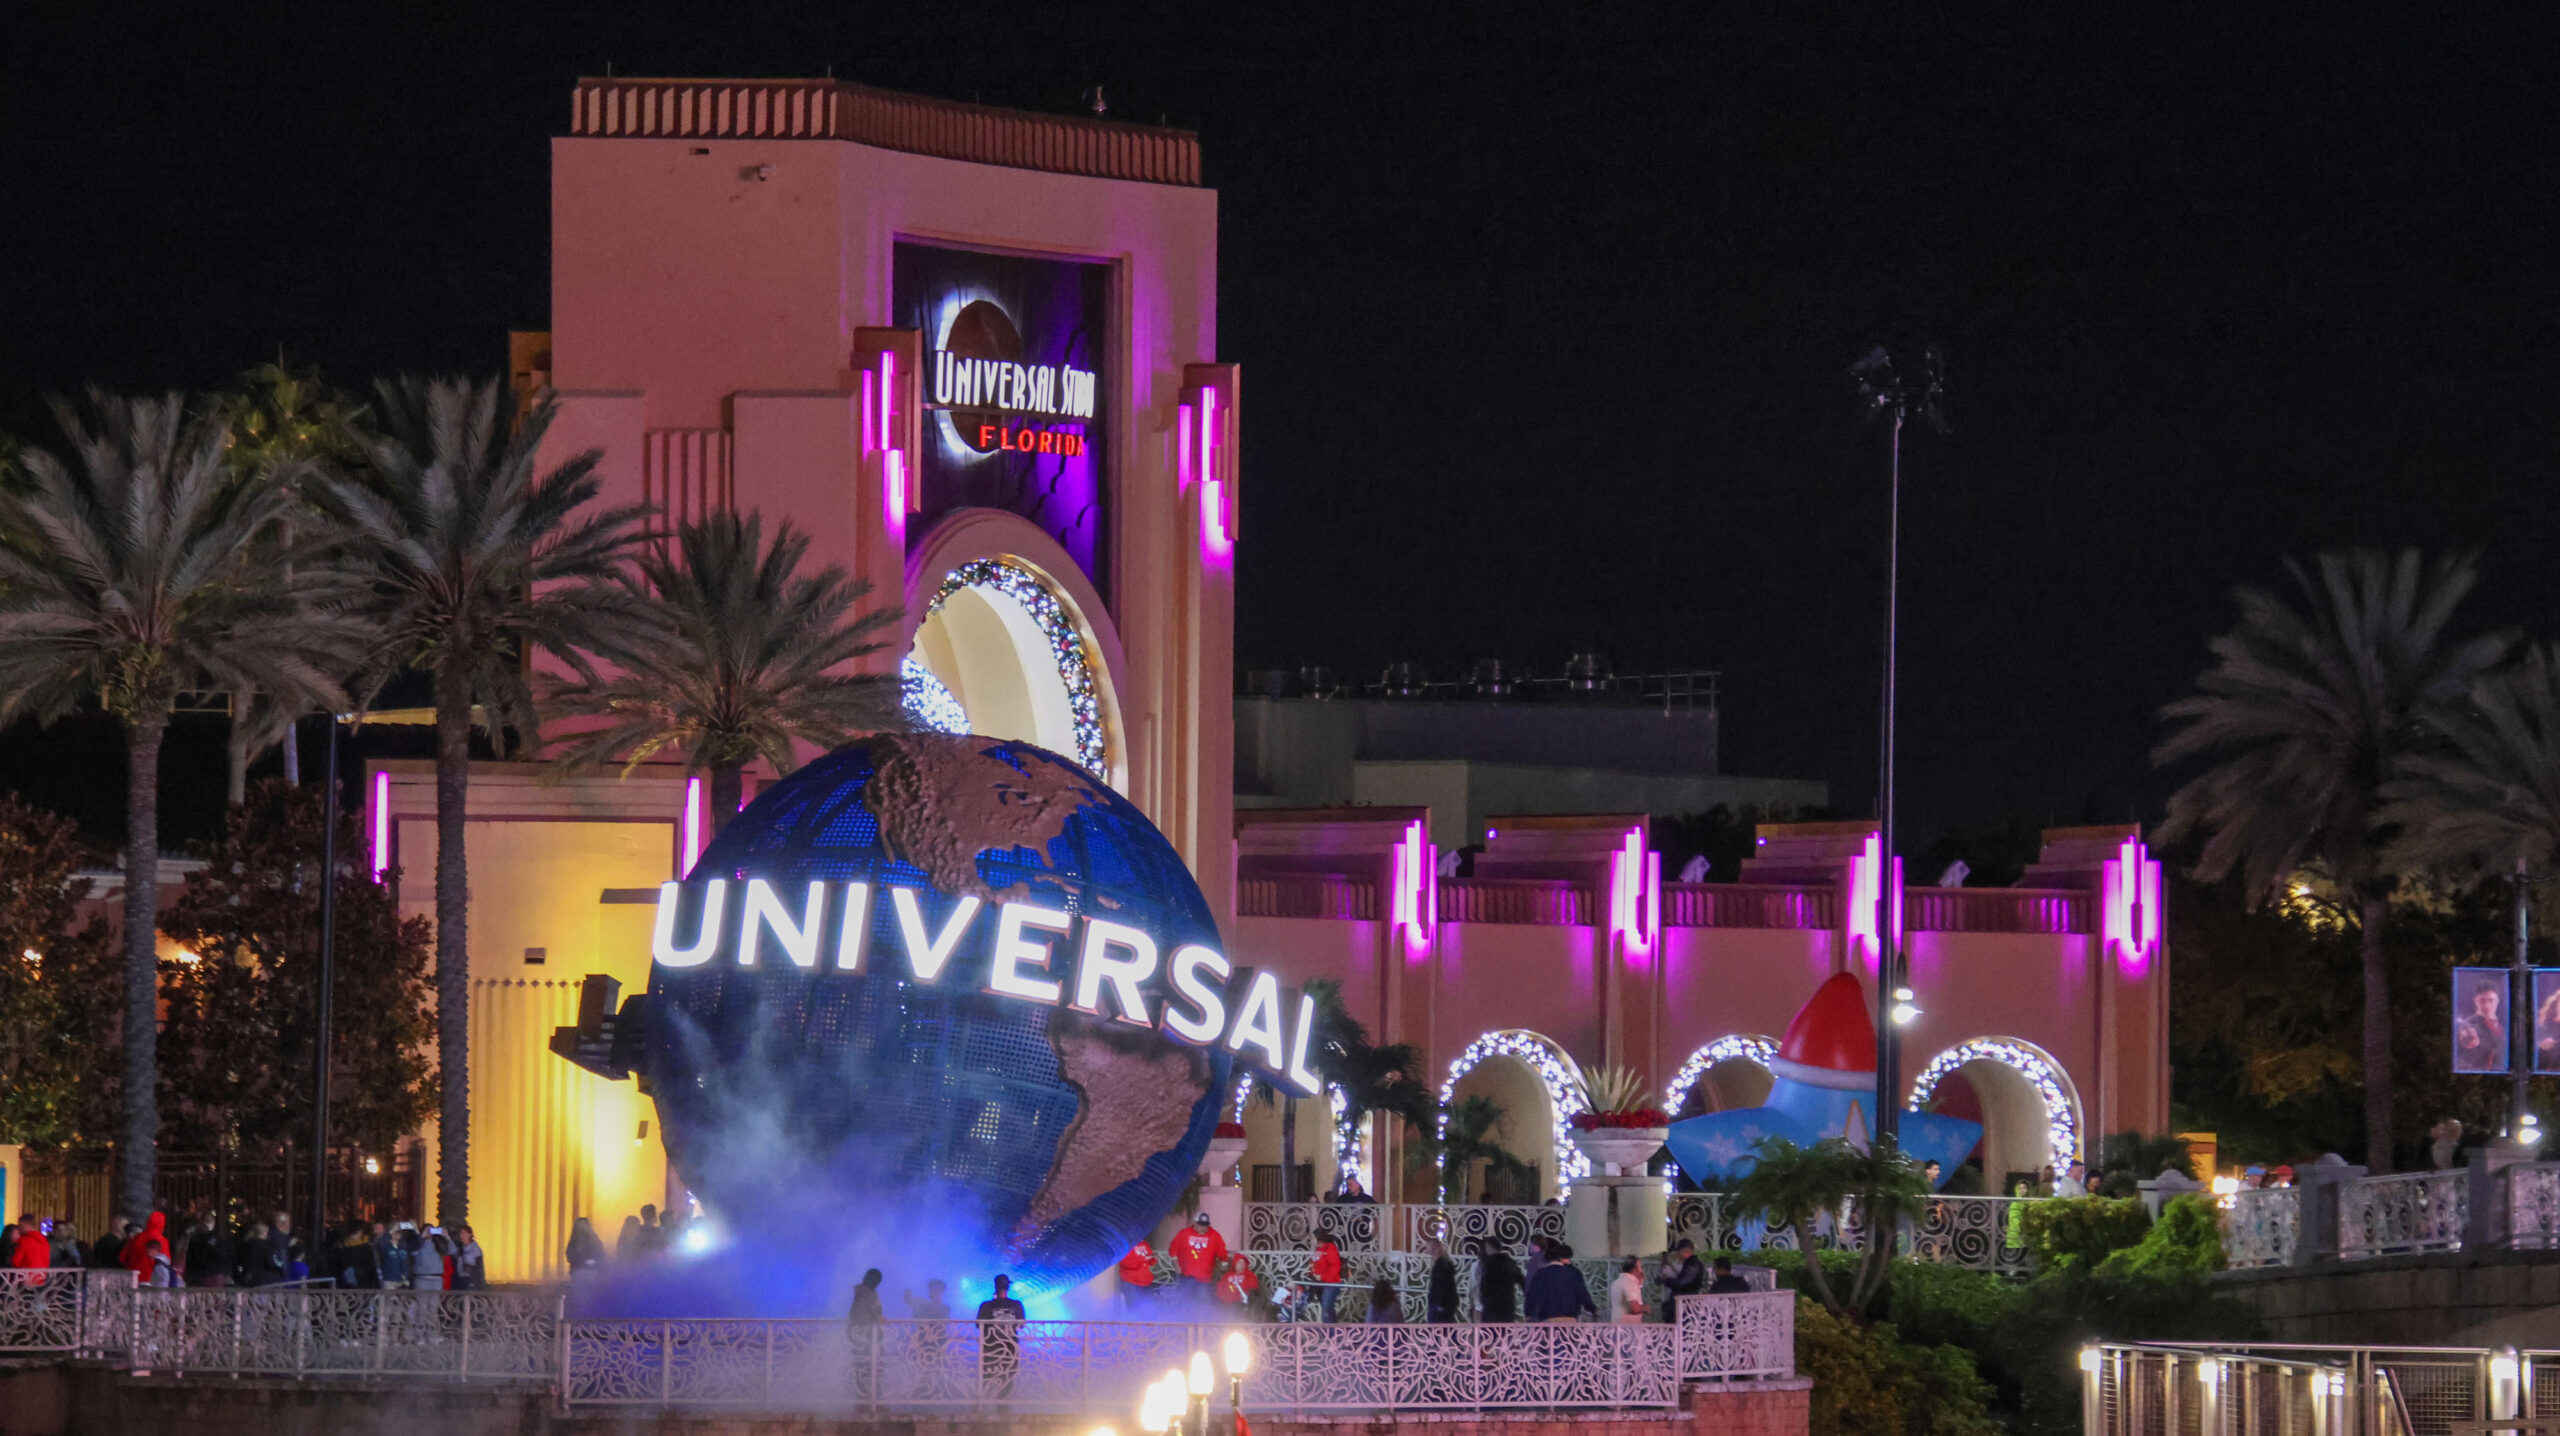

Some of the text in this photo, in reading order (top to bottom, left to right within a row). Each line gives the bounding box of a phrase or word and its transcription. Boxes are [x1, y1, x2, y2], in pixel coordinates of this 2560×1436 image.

[935, 351, 1057, 414] UNIVERSAL
[979, 425, 1084, 457] FLORIDA
[652, 878, 1320, 1095] UNIVERSAL
